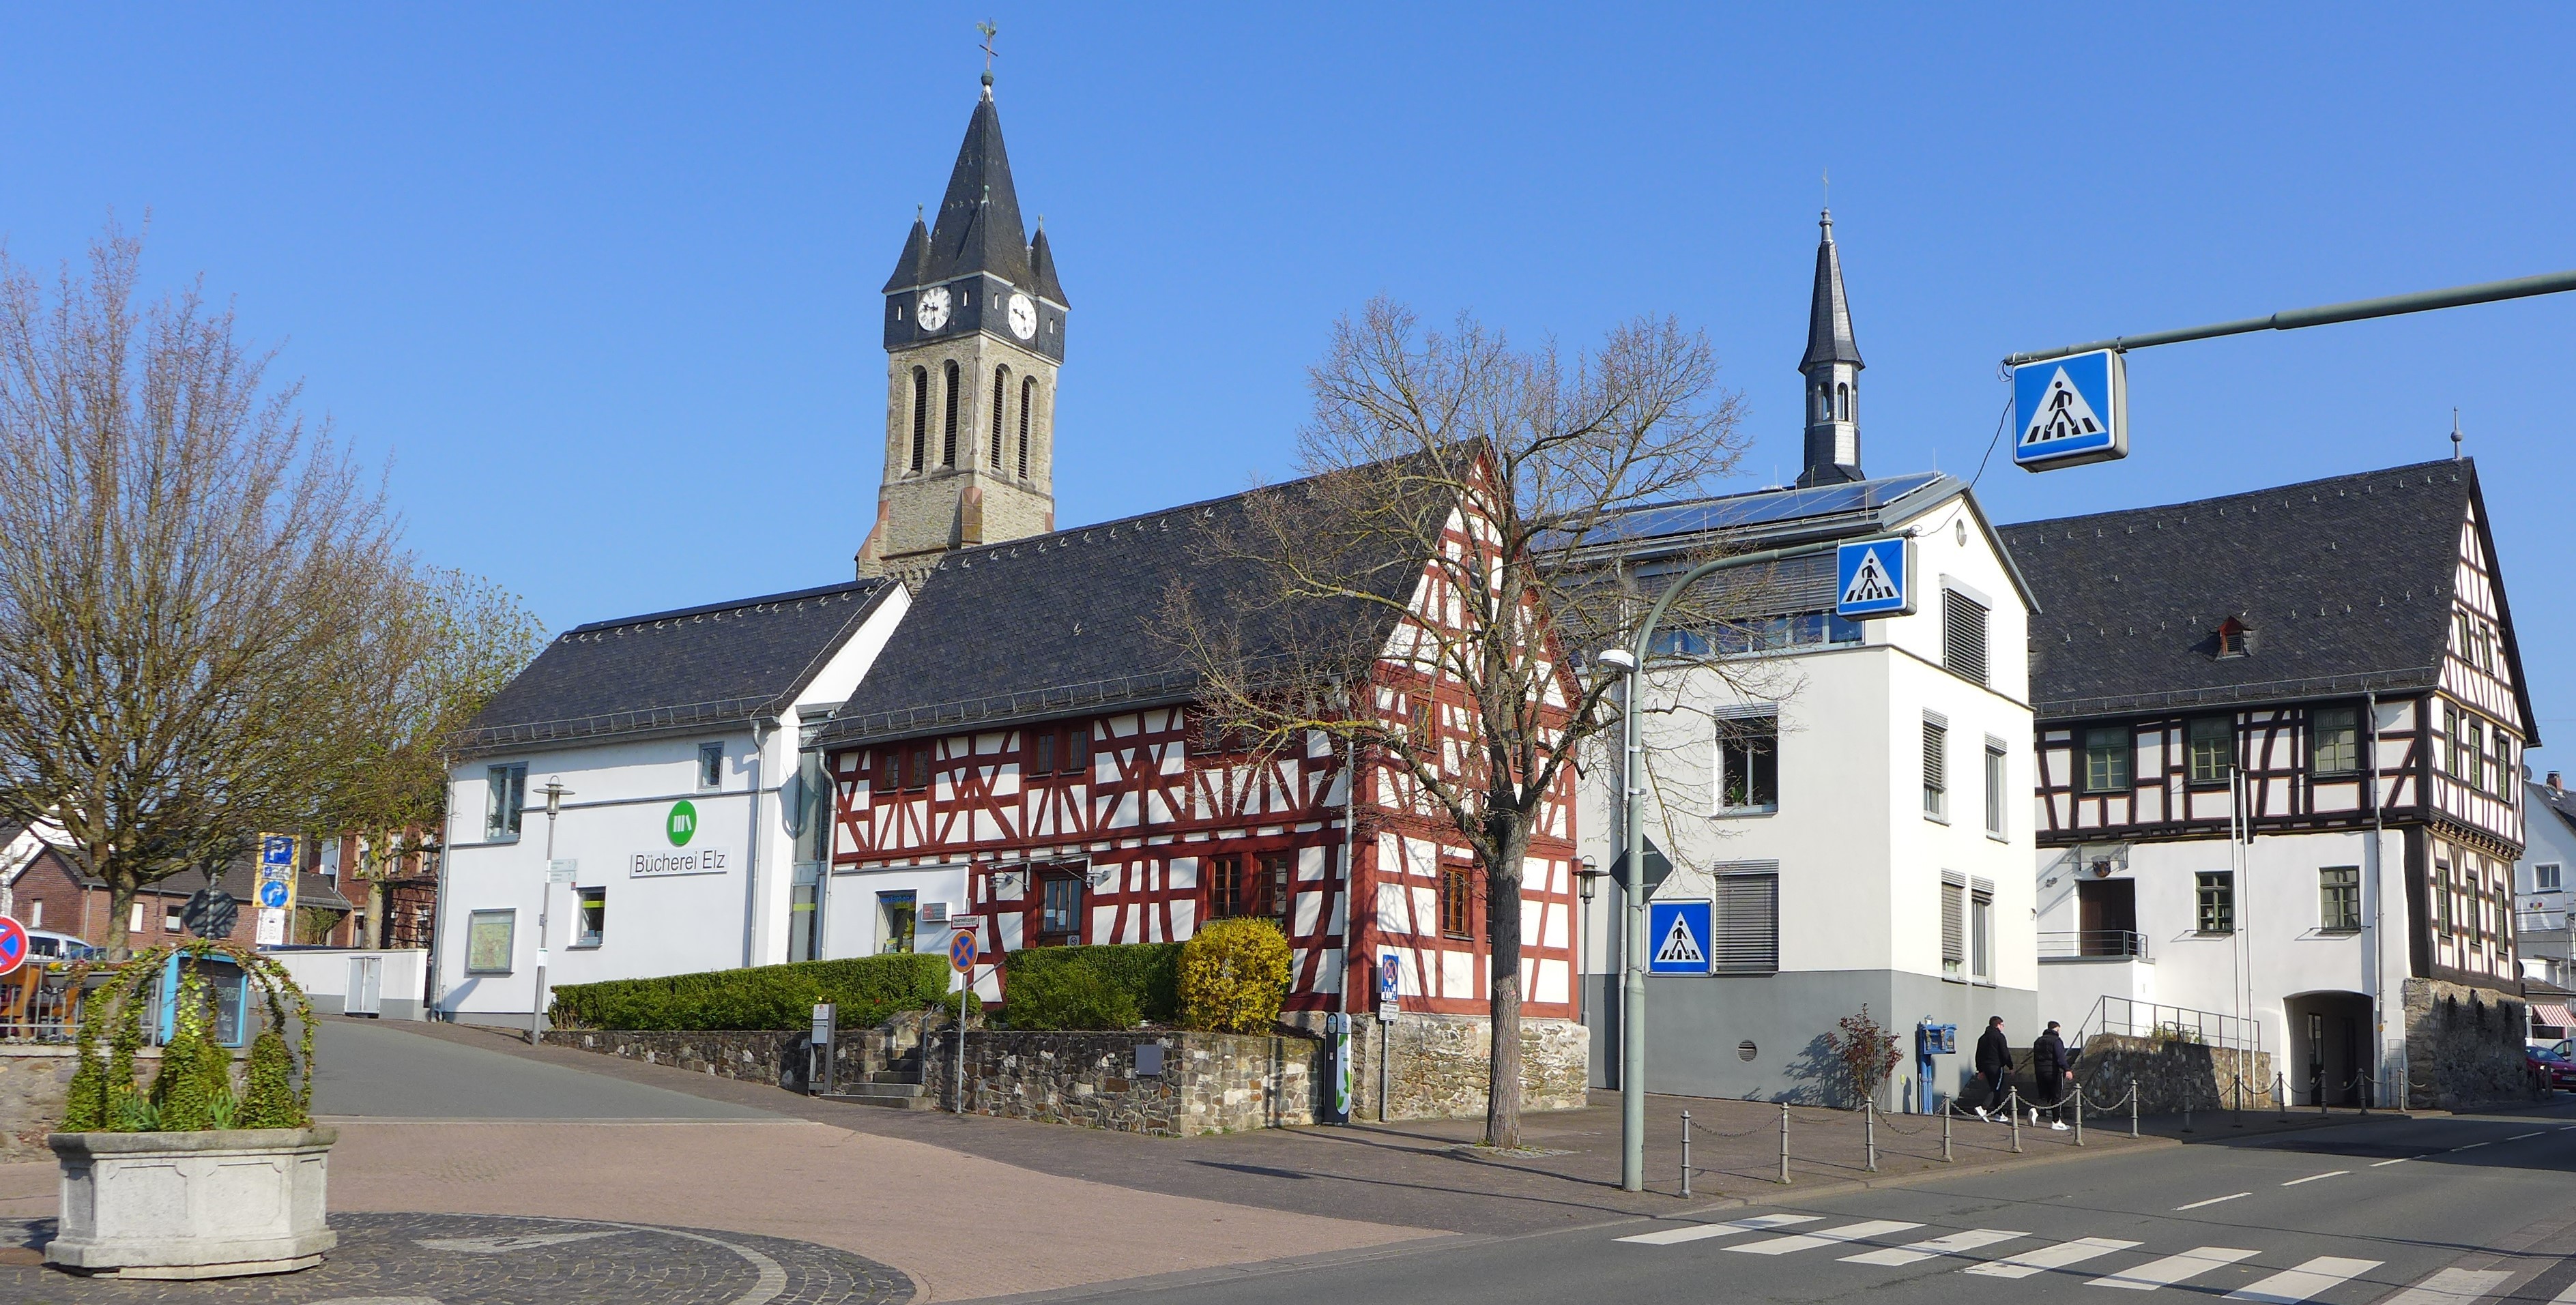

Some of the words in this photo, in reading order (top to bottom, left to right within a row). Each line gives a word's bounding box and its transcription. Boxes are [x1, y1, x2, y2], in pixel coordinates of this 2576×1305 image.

[269, 839, 286, 861] P
[635, 851, 697, 873] Bücherei
[702, 849, 725, 869] Elz
